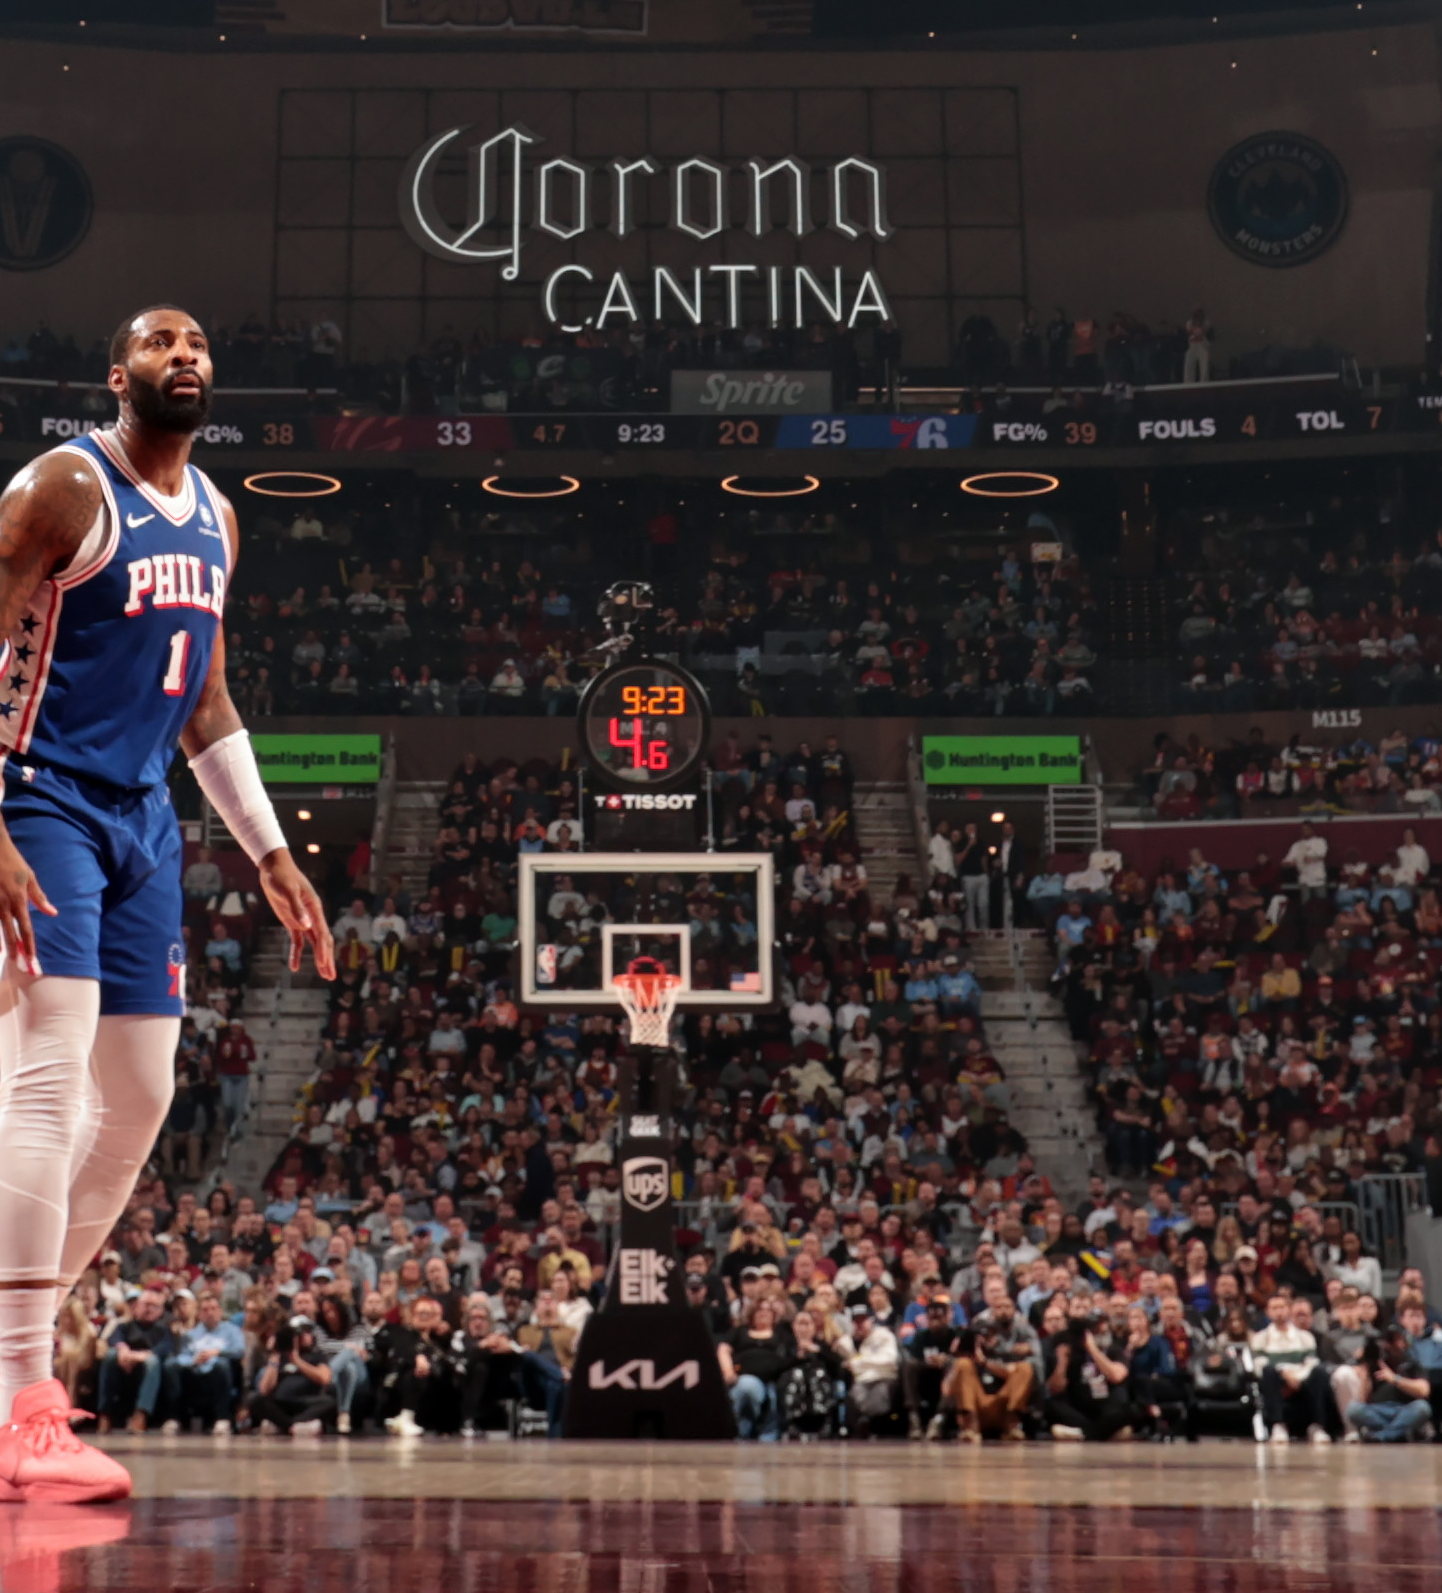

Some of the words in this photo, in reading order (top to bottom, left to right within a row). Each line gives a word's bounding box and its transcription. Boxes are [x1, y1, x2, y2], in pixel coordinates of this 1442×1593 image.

[411, 125, 889, 282] Corona
[1235, 223, 1322, 255] MONSTERS
[544, 265, 890, 332] CANTINA
[698, 371, 806, 412] Sprite
[262, 423, 294, 446] 38
[436, 421, 472, 446] 33
[532, 423, 566, 445] 4.7
[617, 423, 666, 444] 9:23
[718, 421, 759, 447] 2Q
[811, 420, 847, 446] 25
[992, 422, 1048, 444] FG%
[1063, 421, 1098, 445] 39
[1138, 417, 1216, 440] FOULS
[1240, 415, 1257, 438] 4
[1296, 412, 1345, 432] TOL
[1366, 407, 1382, 429] 7
[162, 629, 192, 697] 1
[621, 685, 687, 716] 9:23
[1311, 708, 1362, 728] M115
[338, 751, 378, 766] Bank
[608, 716, 670, 771] 4.6
[948, 752, 1036, 771] Huntington
[1038, 752, 1078, 767] Bank
[621, 793, 698, 809] TISSOT
[628, 1172, 666, 1204] ups
[619, 1276, 669, 1305] Elk
[588, 1358, 700, 1391] KIA
